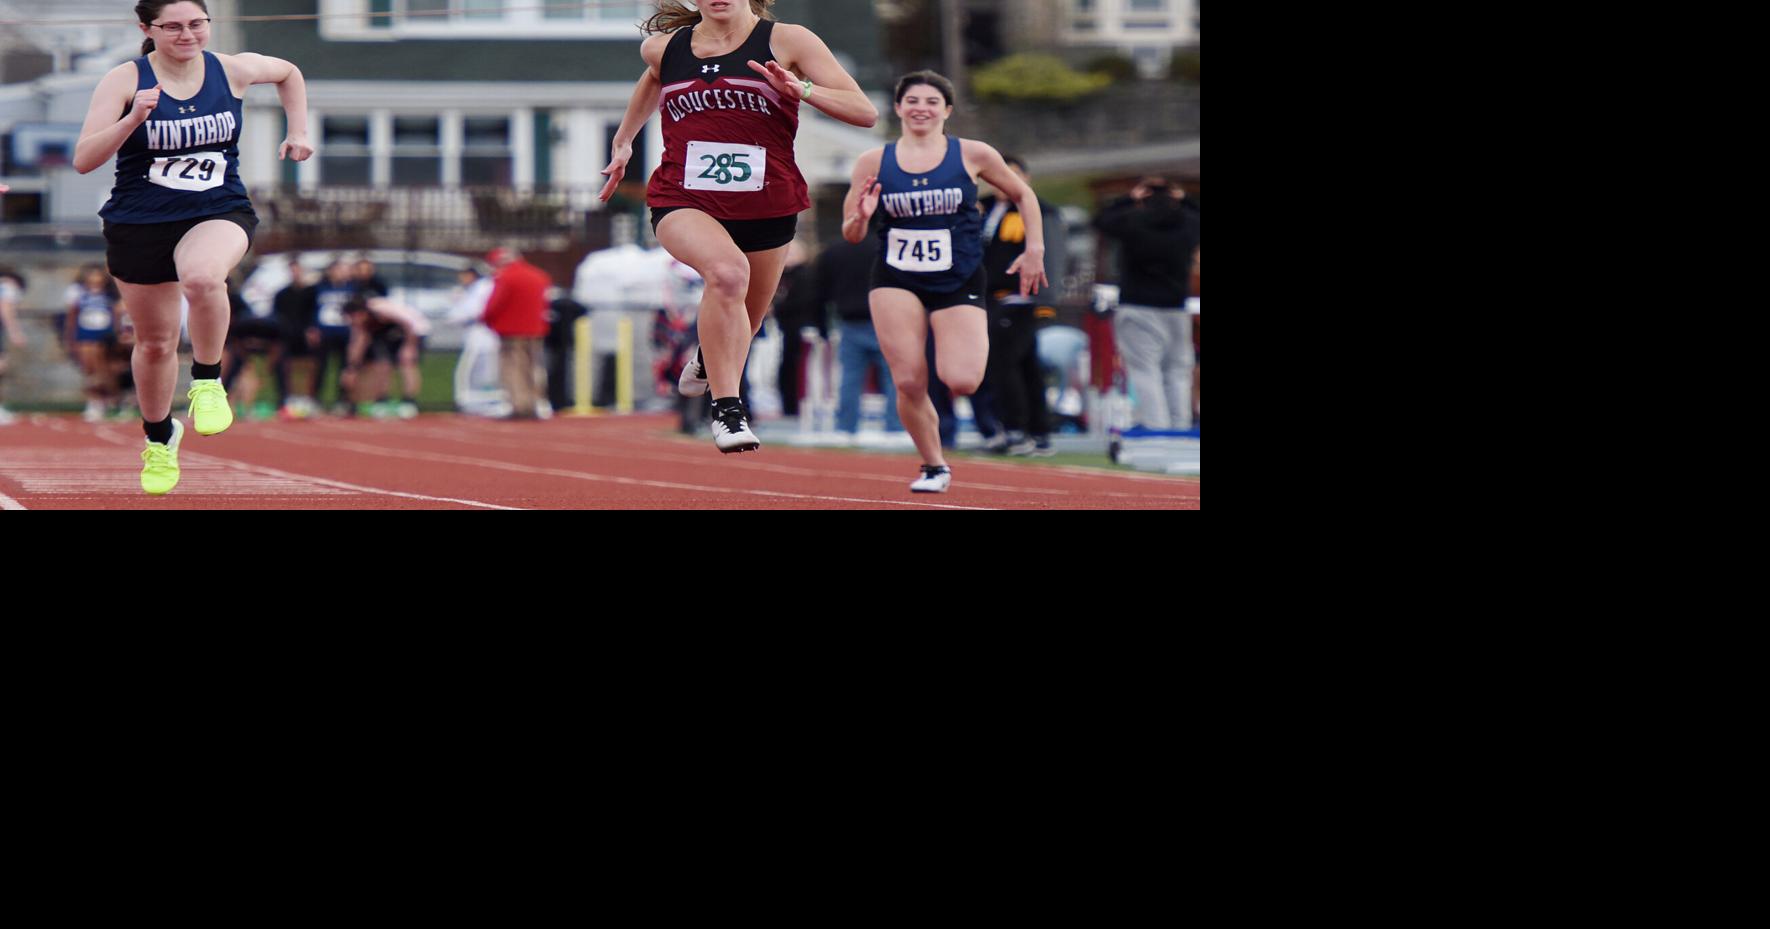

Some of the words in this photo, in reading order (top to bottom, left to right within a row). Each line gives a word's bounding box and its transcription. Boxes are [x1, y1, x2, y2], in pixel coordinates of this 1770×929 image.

[666, 88, 772, 122] GLOUCESTER
[145, 110, 236, 151] WINTHROP
[162, 157, 216, 181] 729
[697, 153, 752, 185] 285
[896, 238, 942, 262] 745
